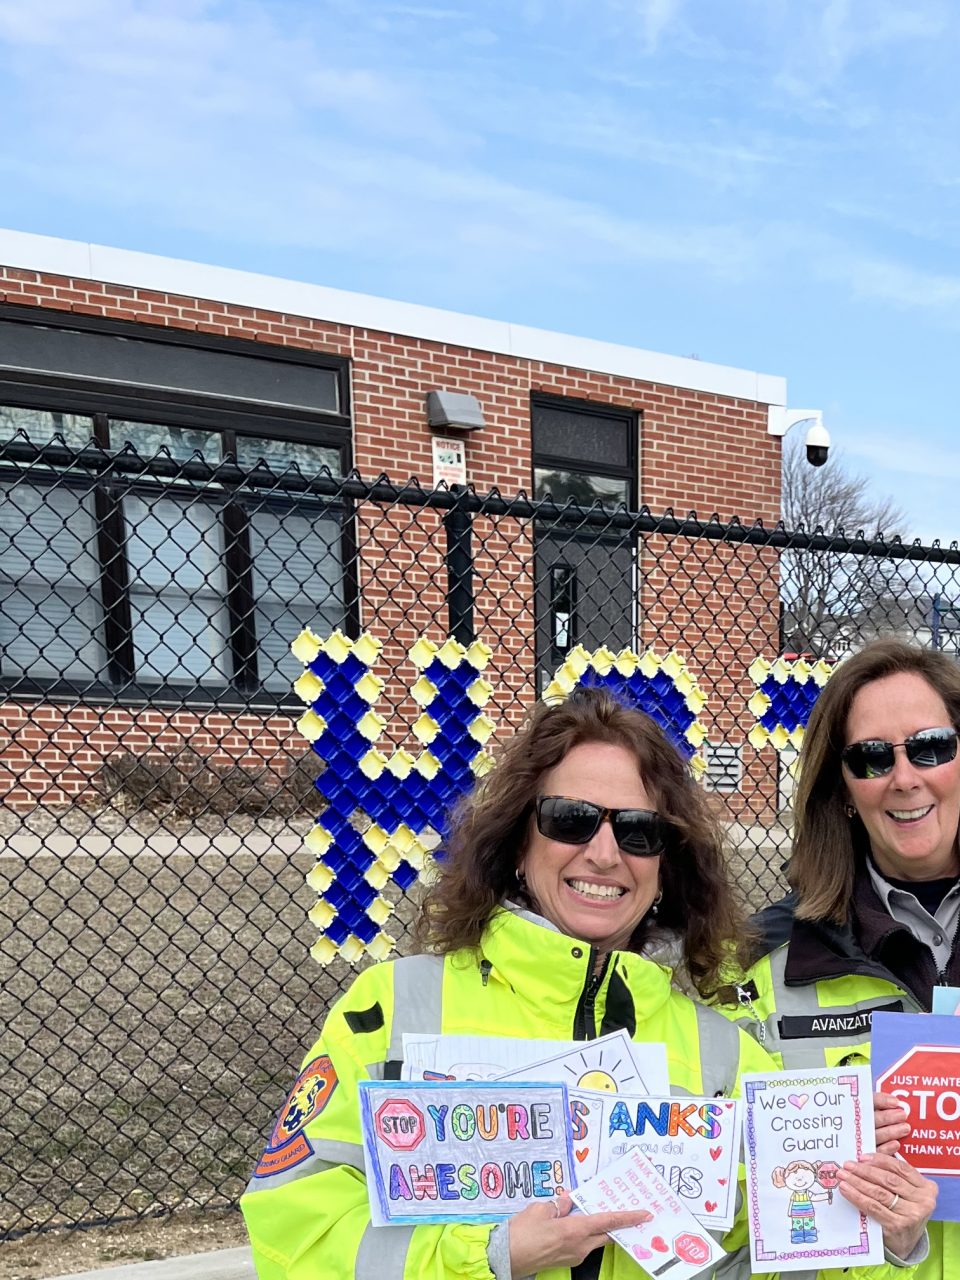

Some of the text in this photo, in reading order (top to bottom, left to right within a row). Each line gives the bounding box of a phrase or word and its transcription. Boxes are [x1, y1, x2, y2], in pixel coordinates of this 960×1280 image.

[890, 1075, 919, 1086] JUST
[759, 1091, 846, 1110] We Our
[382, 1115, 418, 1134] STOP
[426, 1103, 553, 1142] YOU'RE
[609, 1101, 723, 1139] ANKS
[770, 1114, 843, 1133] Crossing
[782, 1133, 840, 1153] Guard!
[911, 1129, 937, 1140] AND
[903, 1144, 943, 1155] THANK
[389, 1160, 564, 1200] AWESOME!
[631, 1152, 682, 1214] THANK YOU FOR
[819, 1170, 837, 1180] STO
[598, 1179, 620, 1204] FROM
[613, 1176, 640, 1206] GET TO
[625, 1168, 665, 1214] HELPING ME
